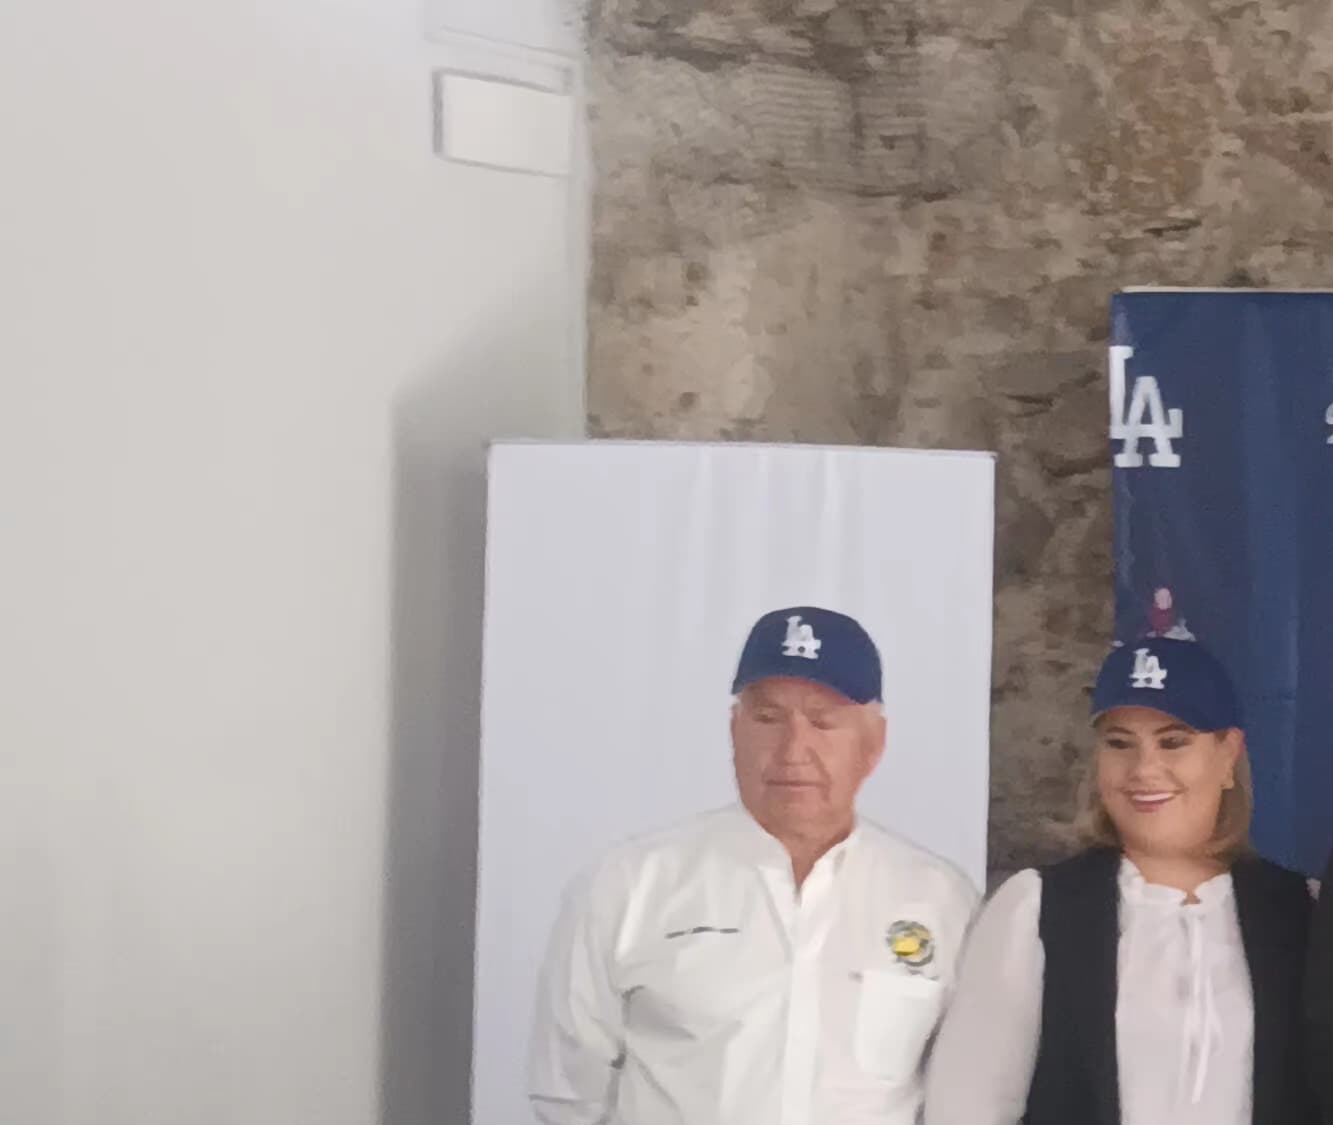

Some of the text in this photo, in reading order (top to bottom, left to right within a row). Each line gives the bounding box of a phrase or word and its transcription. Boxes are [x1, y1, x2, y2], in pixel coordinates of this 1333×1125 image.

[1109, 346, 1183, 467] LA
[781, 615, 821, 659] LA
[1130, 648, 1167, 689] LA
